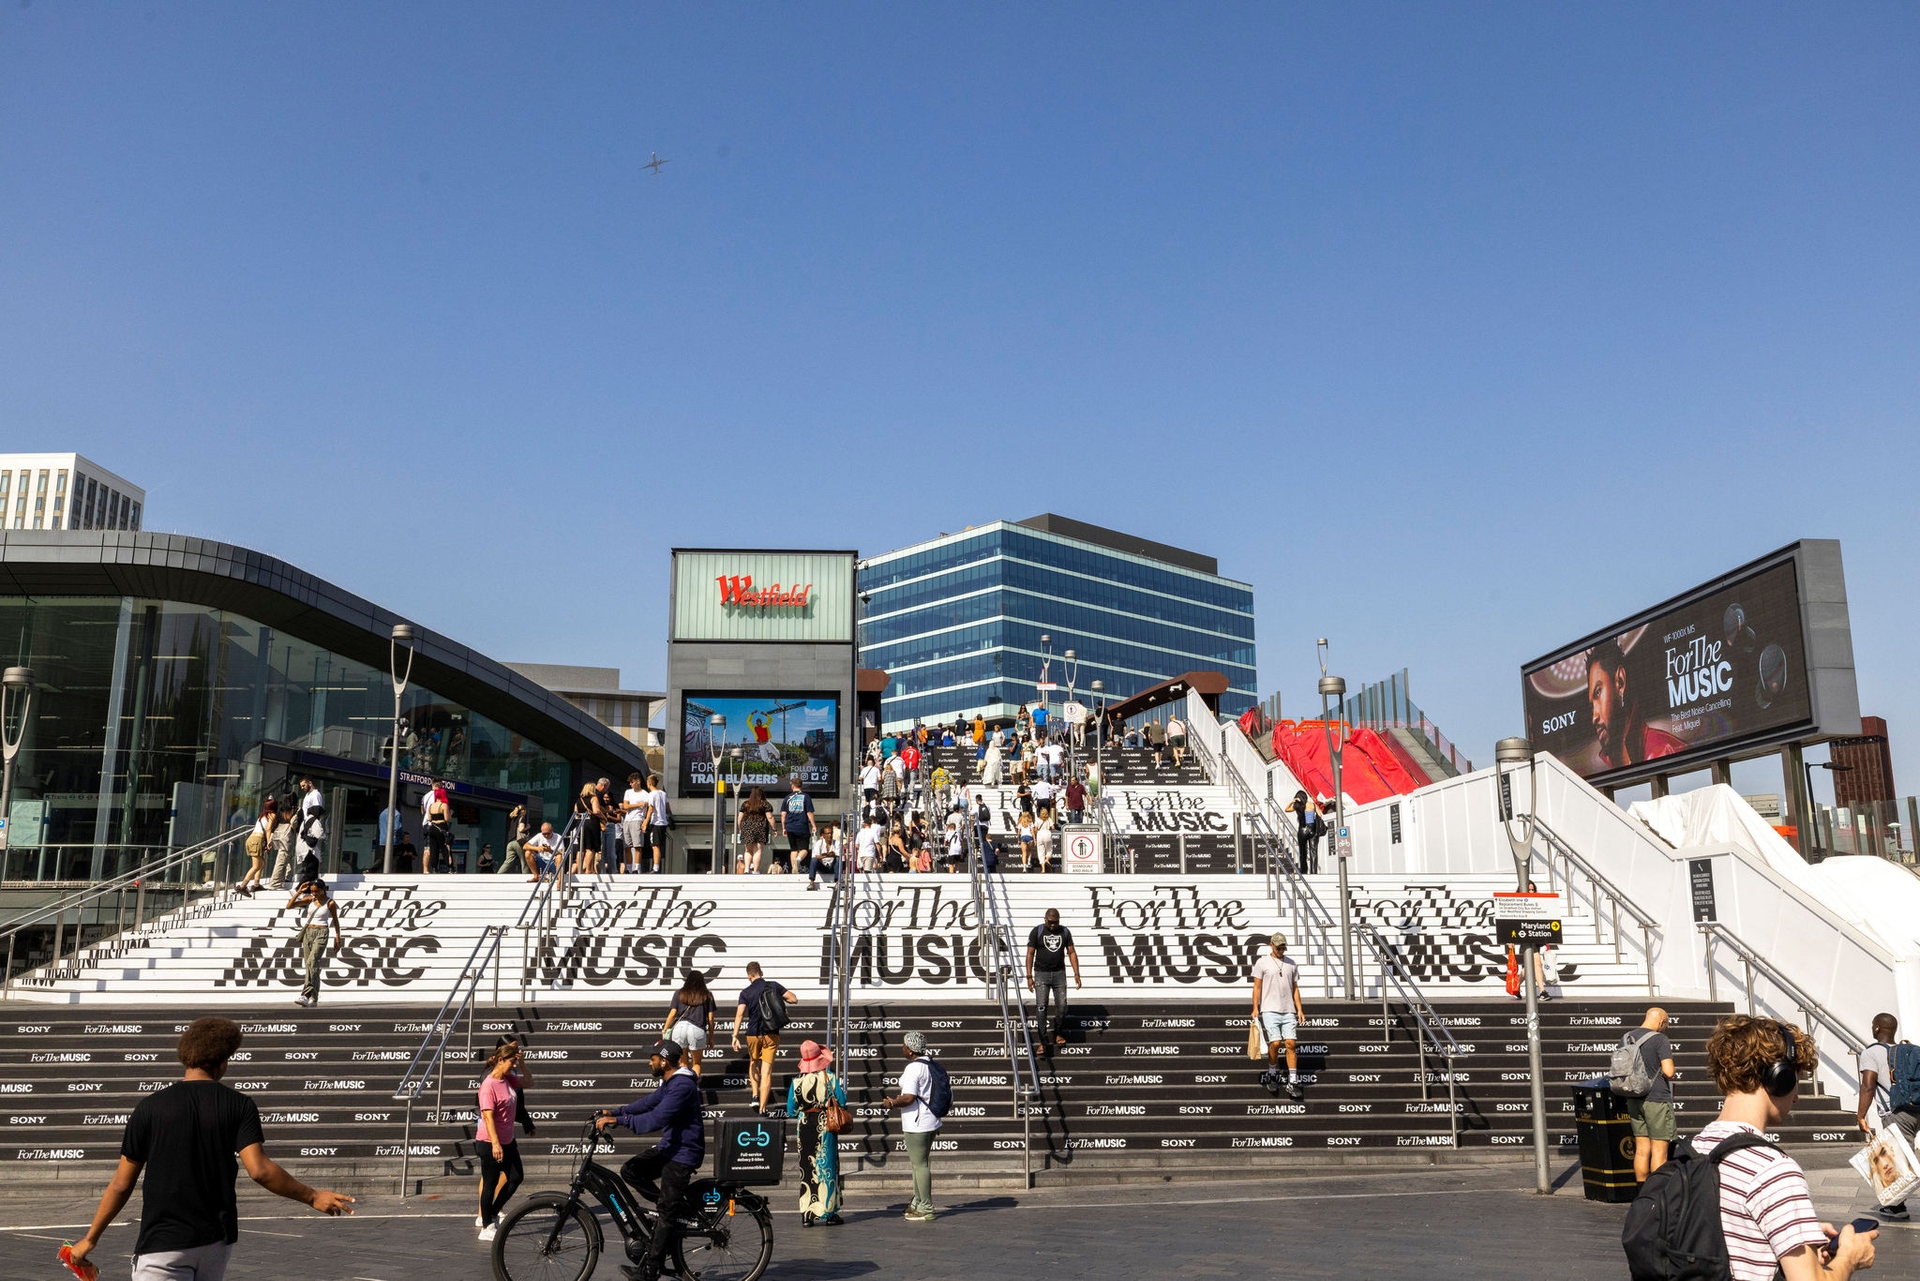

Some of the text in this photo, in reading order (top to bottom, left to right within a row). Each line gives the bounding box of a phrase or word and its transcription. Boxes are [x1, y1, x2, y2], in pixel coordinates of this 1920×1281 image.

[716, 575, 812, 607] Westfield
[1668, 660, 1734, 708] MUSIC
[1680, 708, 1692, 720] Best
[1542, 710, 1577, 735] SONY
[691, 762, 714, 773] FOR
[790, 765, 829, 773] FOLLOW US
[399, 772, 433, 788] STRATFORD
[1131, 811, 1229, 832] MUSIC
[520, 934, 728, 986] MUSIC
[1349, 1074, 1381, 1082] SONY
[67, 1083, 103, 1091] SONY
[562, 1079, 596, 1087] SONY
[856, 1108, 890, 1116] SONY
[1179, 1106, 1213, 1114] SONY
[1338, 1104, 1372, 1112] SONY
[10, 1116, 47, 1124] SONY
[355, 1113, 390, 1121] SONY
[1161, 1139, 1196, 1147] SONY
[1327, 1137, 1361, 1145] SONY
[1491, 1136, 1525, 1144] SONY
[300, 1147, 338, 1156] SONY
